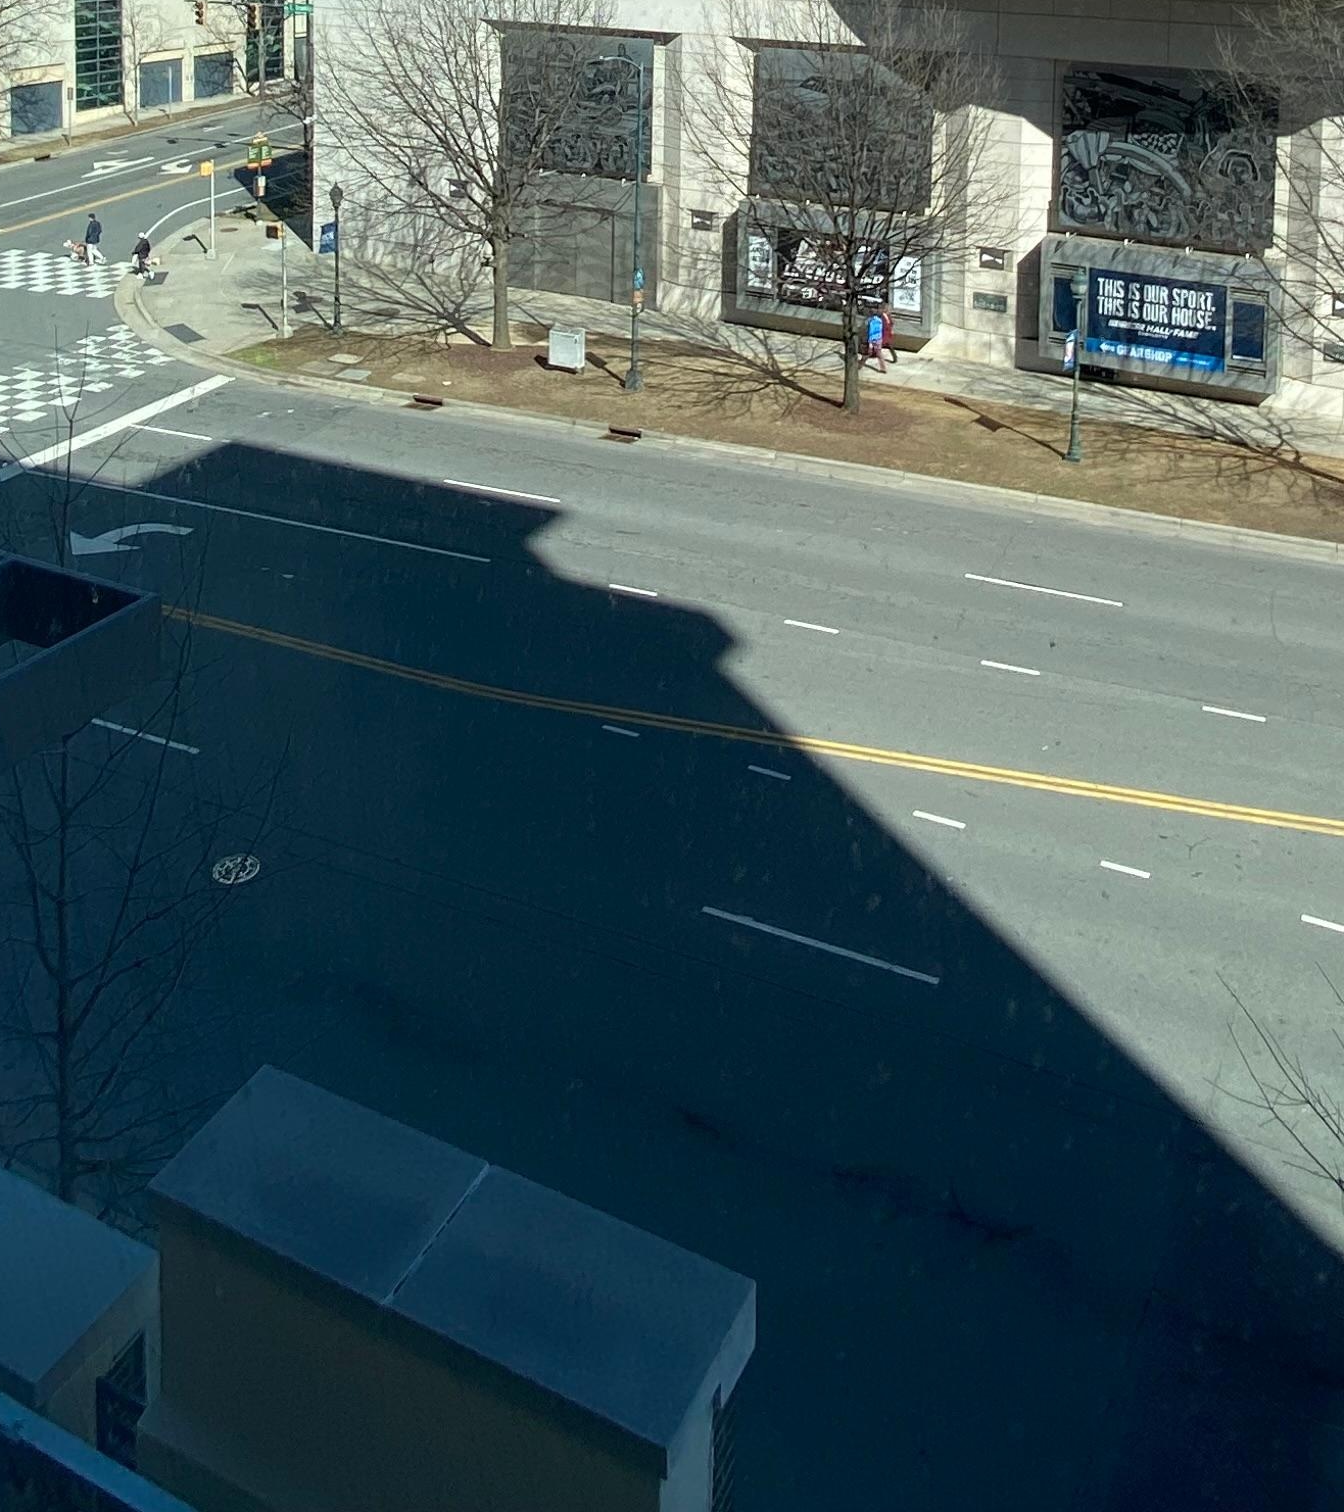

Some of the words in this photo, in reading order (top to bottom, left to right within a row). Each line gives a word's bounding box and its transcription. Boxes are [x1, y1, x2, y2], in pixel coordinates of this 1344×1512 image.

[1097, 277, 1125, 299] THIS
[1128, 282, 1141, 301] IS
[1143, 284, 1169, 306] OUR
[1172, 288, 1217, 312] SPORT.
[1097, 295, 1125, 317] THIS
[1127, 301, 1140, 320] IS
[1142, 303, 1168, 324] OUR
[1171, 307, 1217, 331] HOUSE.
[1144, 348, 1173, 363] SHOP
